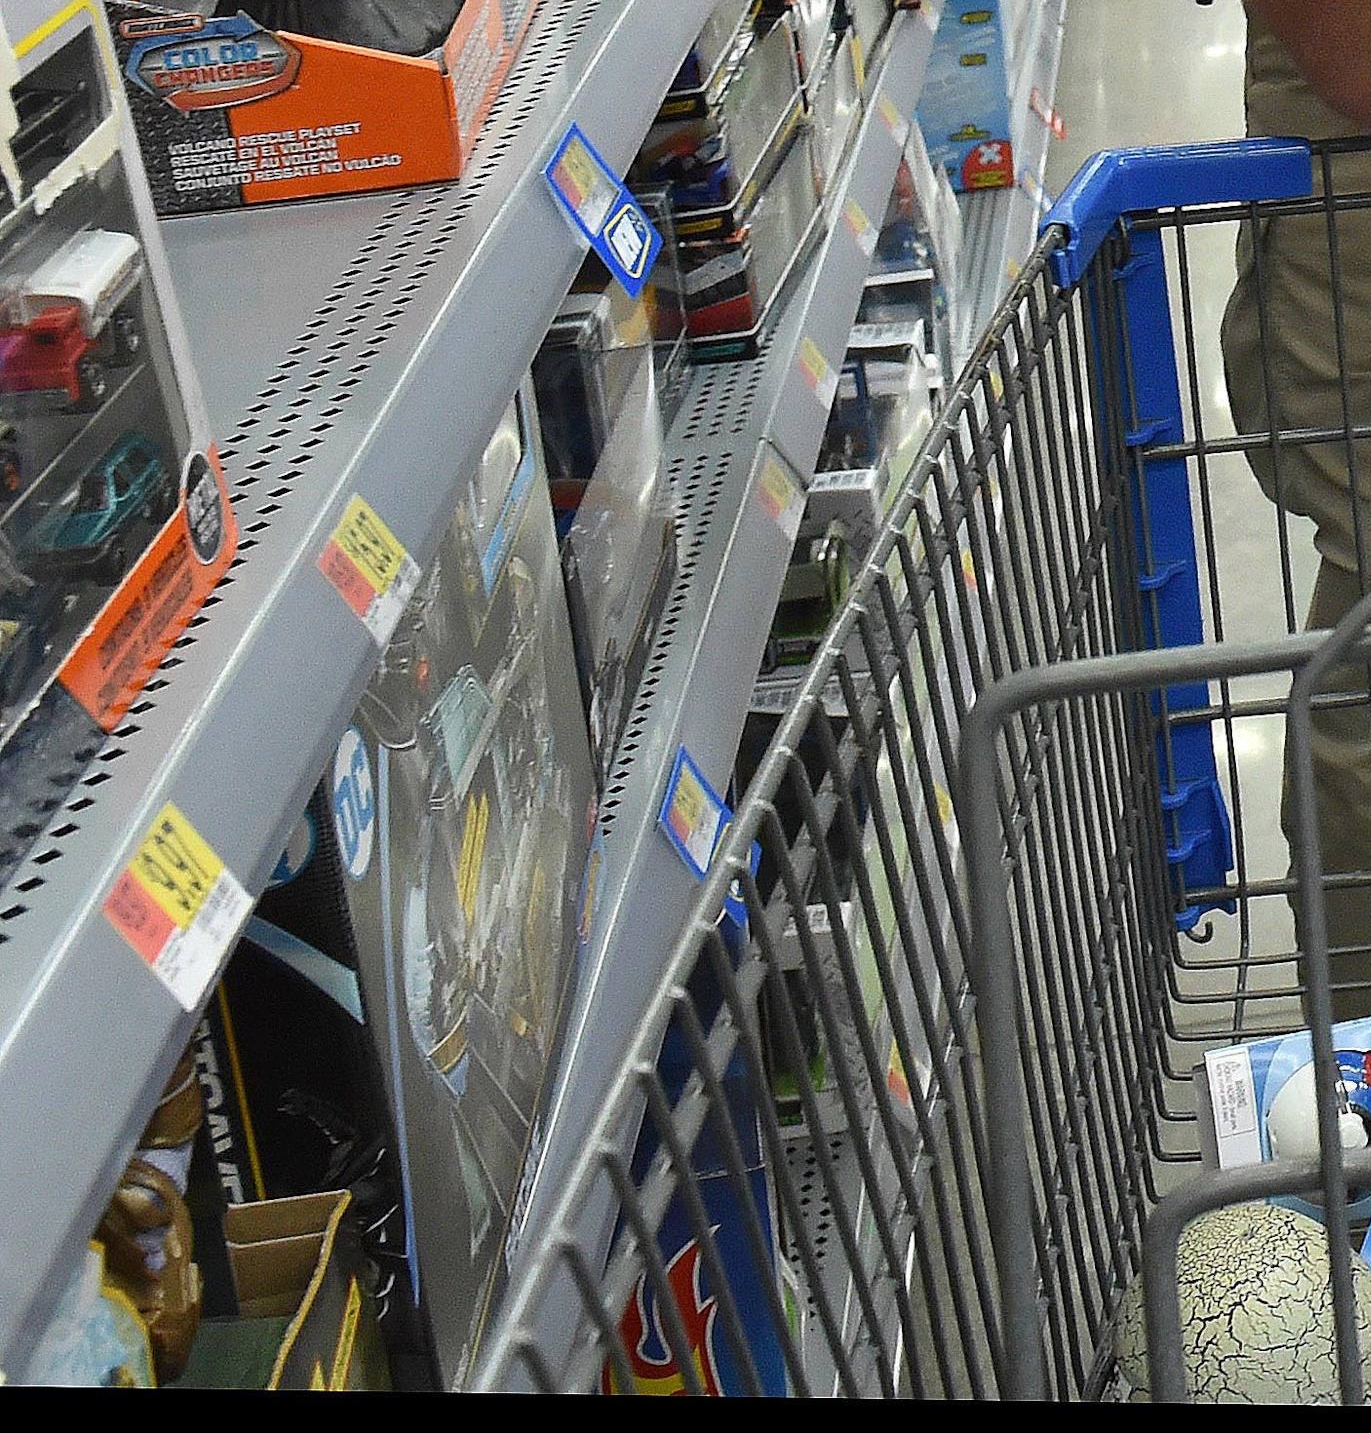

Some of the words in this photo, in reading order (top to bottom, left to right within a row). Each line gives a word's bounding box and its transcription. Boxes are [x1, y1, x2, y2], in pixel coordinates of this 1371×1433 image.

[169, 137, 235, 155] VOLCANO
[239, 130, 296, 147] RESCUE
[298, 122, 362, 140] PLAYSET
[170, 151, 238, 168] RESCATE
